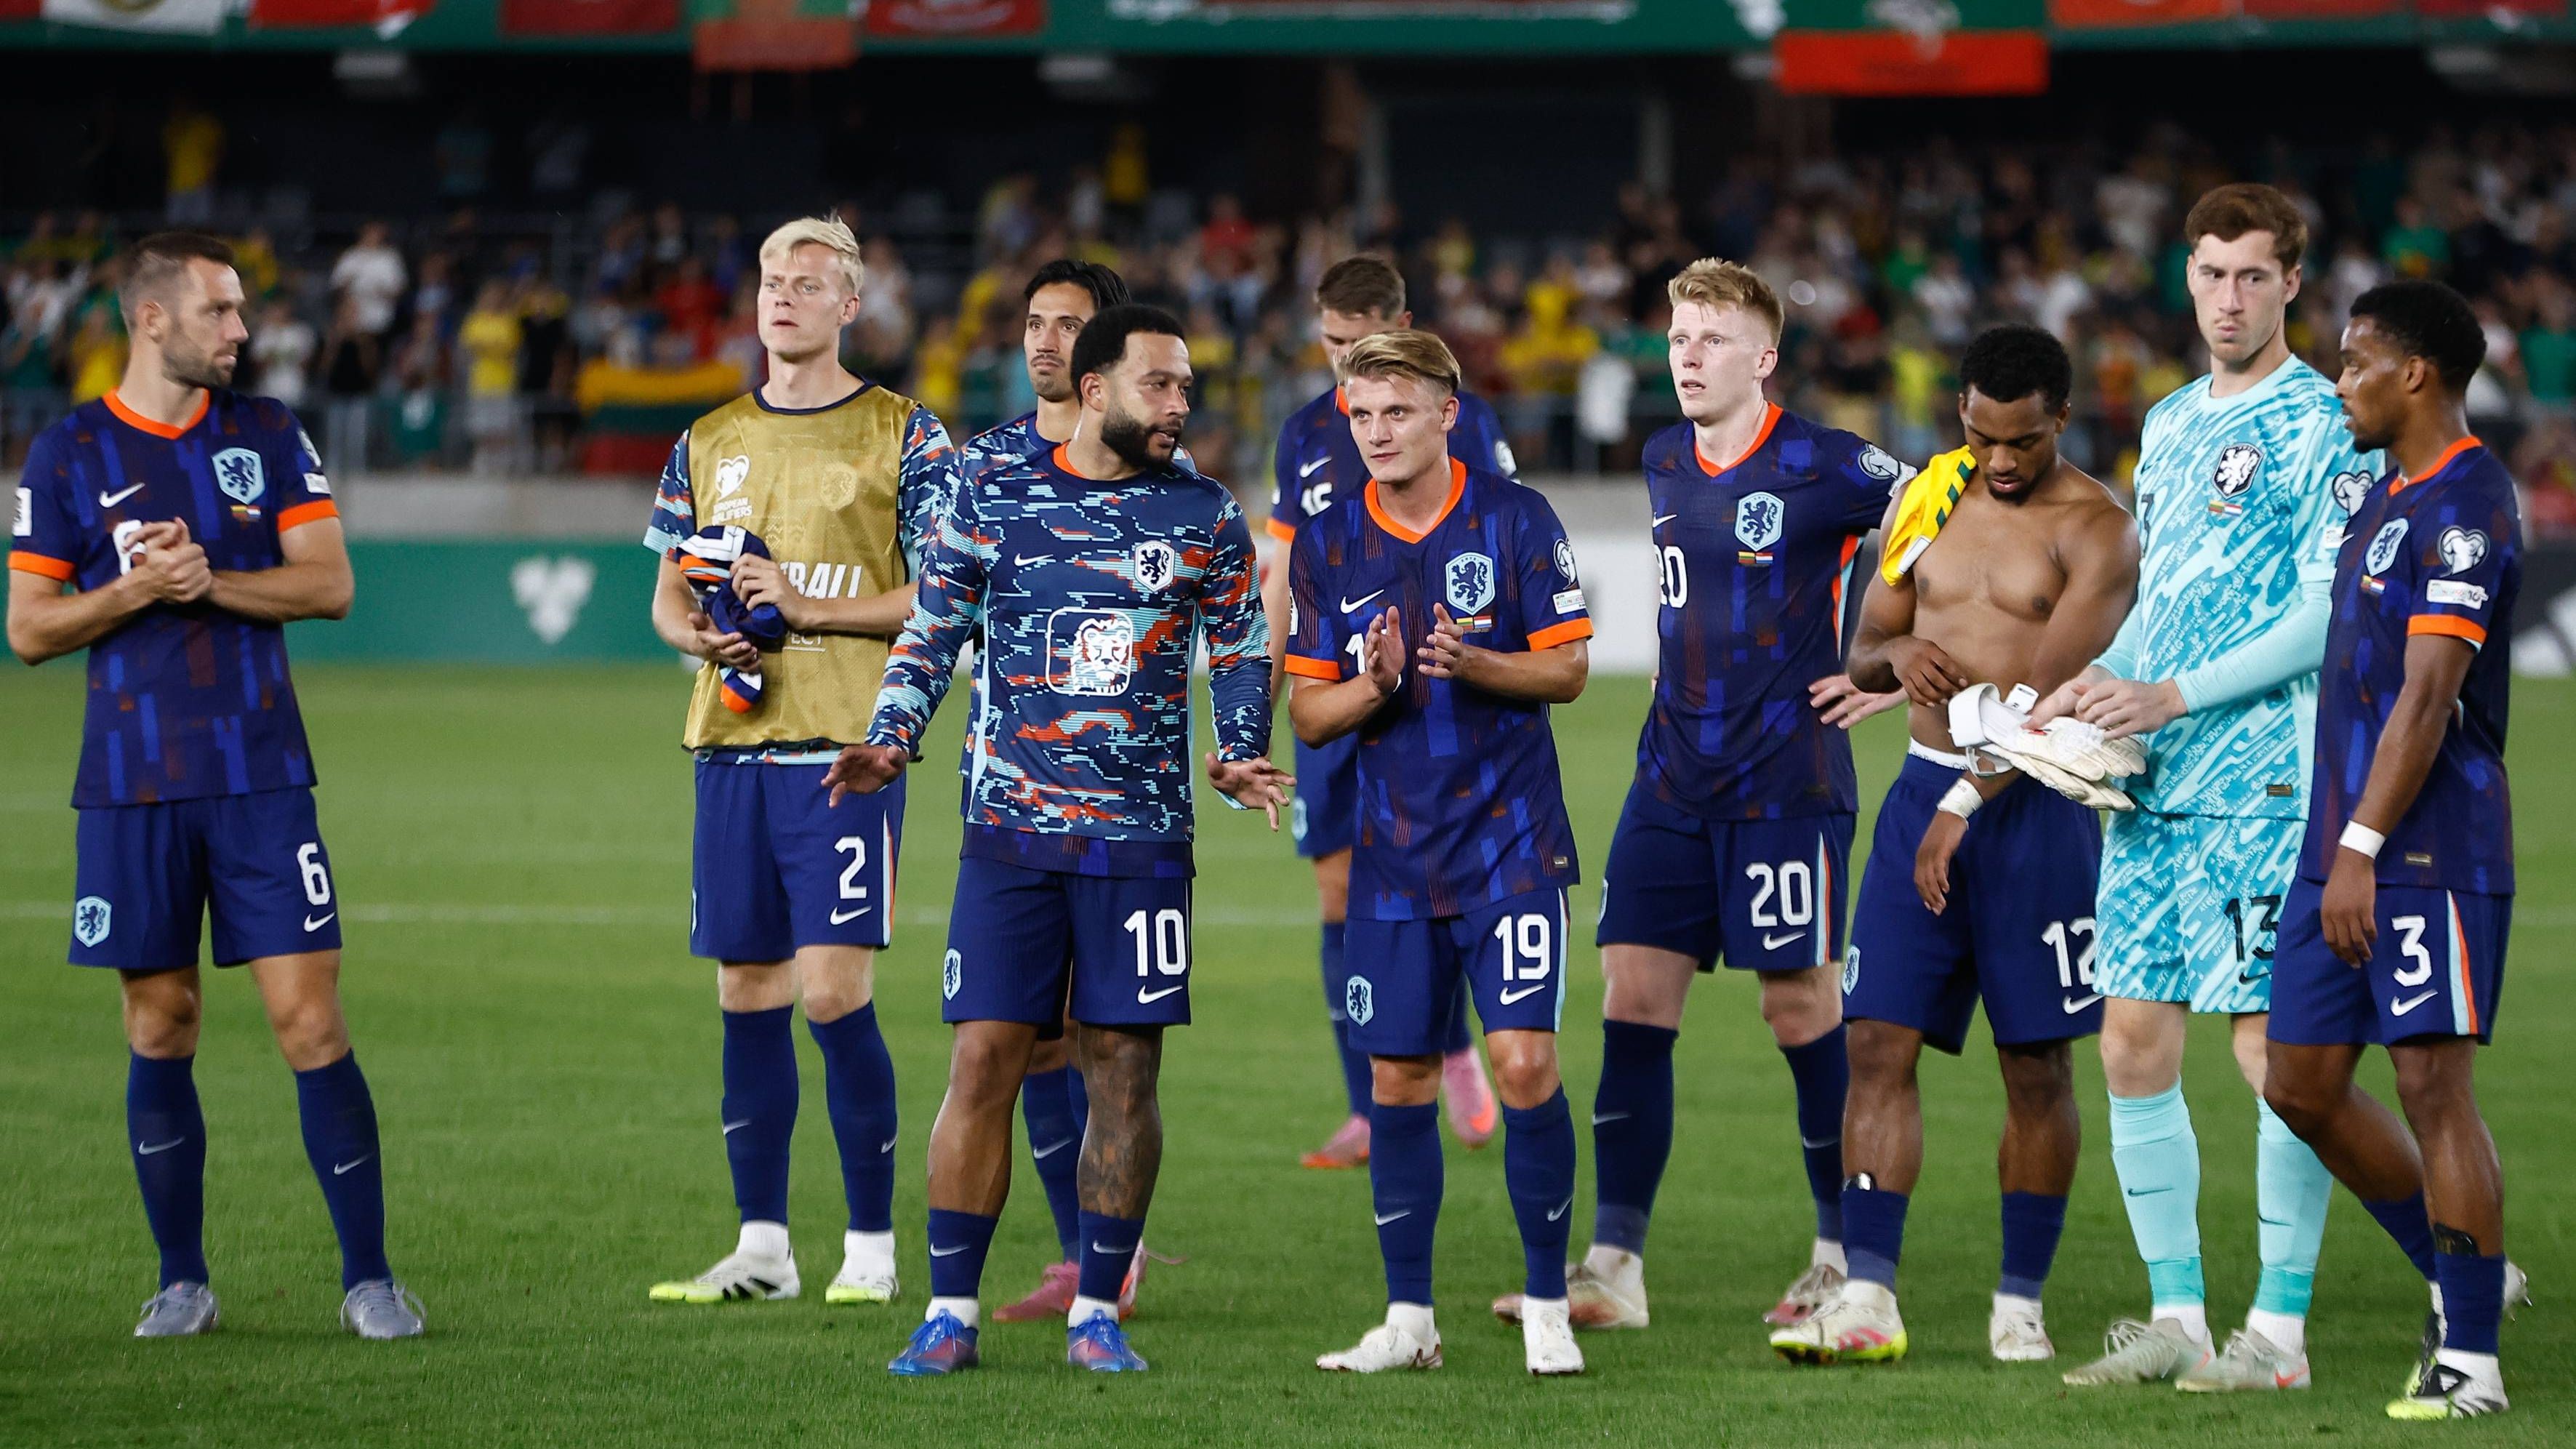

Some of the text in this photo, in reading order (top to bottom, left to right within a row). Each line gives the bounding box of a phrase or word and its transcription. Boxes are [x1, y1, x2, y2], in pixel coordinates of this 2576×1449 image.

[297, 842, 331, 906] 6
[834, 836, 867, 899] 2
[1746, 860, 1813, 927] 20
[1123, 908, 1187, 977] 10
[1494, 913, 1551, 982] 19
[2042, 916, 2096, 987] 12
[2223, 895, 2280, 962] 13
[2391, 914, 2433, 987] 3
